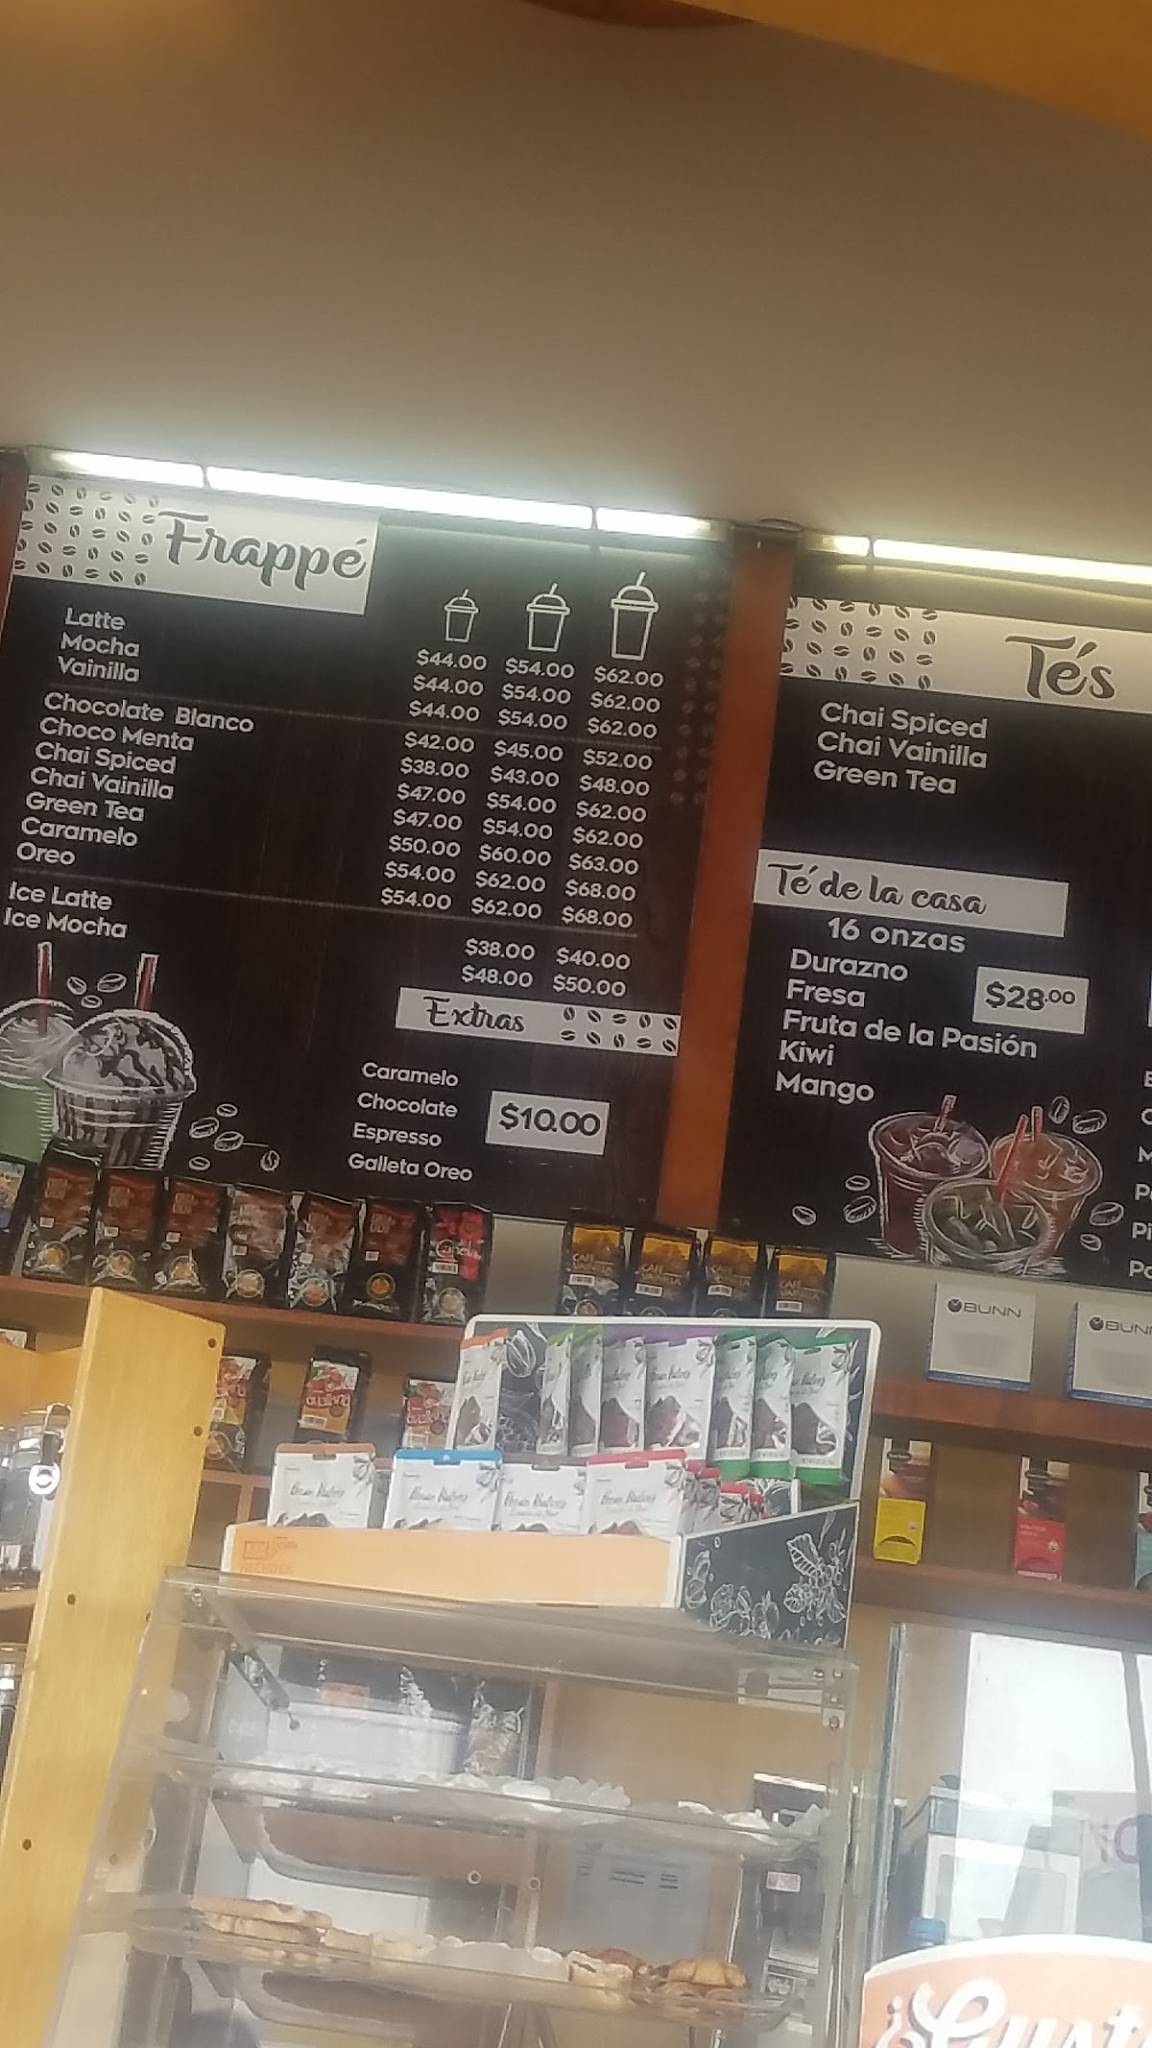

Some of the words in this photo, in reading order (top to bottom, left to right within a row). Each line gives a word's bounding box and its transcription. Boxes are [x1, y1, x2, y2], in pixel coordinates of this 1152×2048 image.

[159, 511, 366, 590] Frappé
[64, 607, 126, 630] Latte
[60, 632, 139, 657] Mocha
[58, 656, 139, 683] Vainilla
[417, 648, 486, 671] $44.00
[505, 657, 574, 679] $54.00
[594, 666, 663, 688] $62.00
[1005, 635, 1116, 700] Tés
[413, 674, 484, 696] $44.00
[502, 683, 571, 705] $54.00
[590, 691, 660, 713] $62.00
[44, 691, 164, 723] Chocolate
[175, 706, 254, 733] Blanco
[409, 700, 480, 723] $44.00
[498, 709, 567, 730] $54.00
[587, 717, 657, 740] $62.00
[821, 702, 884, 728] Chai
[891, 710, 988, 739] Spiced
[39, 716, 116, 742] Choco
[122, 725, 194, 752] Menta
[404, 731, 474, 753] $42.00
[494, 740, 563, 762] $45.00
[583, 748, 653, 770] $52.00
[817, 731, 880, 757] Chai
[888, 739, 987, 768] Vainilla
[35, 741, 90, 765] Chai
[95, 749, 176, 775] Spiced
[30, 766, 85, 789] Chai
[92, 772, 174, 800] Vainilla
[401, 757, 469, 779] $38.00
[490, 766, 559, 788] $43.00
[579, 775, 649, 796] $48.00
[813, 760, 898, 788] Green
[906, 769, 957, 794] Tea
[25, 791, 98, 816] Green
[104, 800, 145, 822] Tea
[397, 783, 465, 805] $47.00
[486, 792, 556, 814] $54.00
[576, 801, 646, 823] $62.00
[21, 816, 138, 847] Caramelo
[393, 808, 462, 831] $47.00
[482, 818, 552, 840] $54.00
[572, 826, 643, 849] $62.00
[16, 842, 75, 866] Oreo
[389, 835, 460, 857] $50.00
[479, 844, 551, 866] $60.00
[569, 853, 639, 875] $63.00
[9, 880, 46, 904] Ice
[52, 886, 112, 911] Latte
[384, 861, 455, 883] $54.00
[475, 870, 545, 892] $62.00
[565, 879, 635, 901] $68.00
[768, 863, 819, 897] Té
[820, 870, 862, 900] de
[869, 875, 902, 905] la
[912, 889, 987, 915] casa
[3, 907, 41, 930] Ice
[46, 912, 128, 939] Mocha
[381, 887, 451, 910] $54.00
[471, 897, 542, 919] $62.00
[562, 905, 632, 928] $68.00
[828, 917, 858, 941] 16
[870, 926, 966, 953] onzas
[466, 938, 535, 961] $38.00
[556, 947, 630, 970] $40.00
[790, 948, 909, 981] Durazno
[462, 965, 533, 987] $48.00
[553, 974, 626, 997] $50.00
[786, 979, 866, 1007] Fresa
[423, 997, 525, 1032] Extras
[783, 1009, 857, 1038] Fruta
[864, 1018, 901, 1043] de
[909, 1023, 934, 1046] la
[942, 1026, 1038, 1059] Pasión
[779, 1040, 834, 1066] Kiwi
[362, 1062, 458, 1087] Caramelo
[775, 1070, 875, 1103] Mango
[357, 1092, 457, 1117] Chocolate
[499, 1102, 601, 1137] $10.00
[353, 1123, 442, 1147] Espresso
[348, 1153, 419, 1177] Galleta
[424, 1161, 473, 1182] Oreo
[964, 1302, 1021, 1318] BUNN
[1105, 1321, 1152, 1334] BUN
